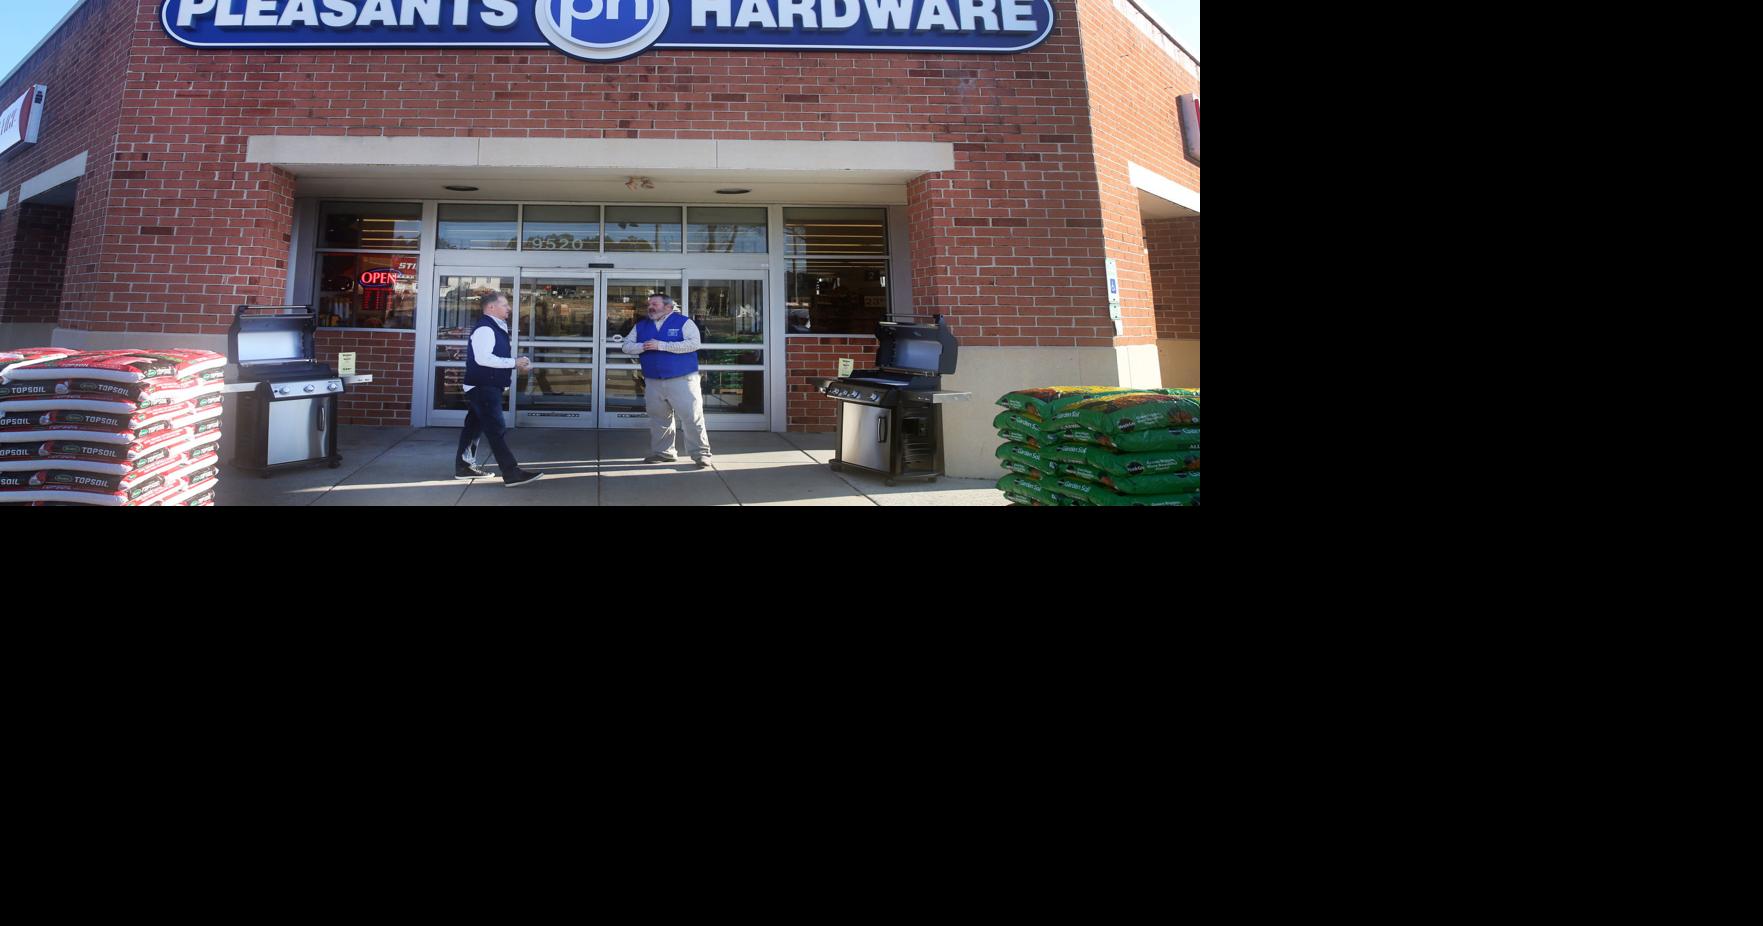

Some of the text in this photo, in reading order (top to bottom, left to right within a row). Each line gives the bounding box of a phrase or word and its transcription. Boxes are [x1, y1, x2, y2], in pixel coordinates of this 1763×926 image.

[176, 0, 518, 28] PLEASANTS
[691, 0, 1038, 32] HARDWARE
[532, 238, 583, 250] 9520
[361, 271, 397, 284] OPEN
[12, 386, 46, 394] TOPSOIL
[98, 384, 129, 397] TOPSOIL
[85, 415, 119, 426] TOPSOIL
[82, 446, 117, 458] TOPSOIL
[74, 476, 109, 488] TOPSOIL
